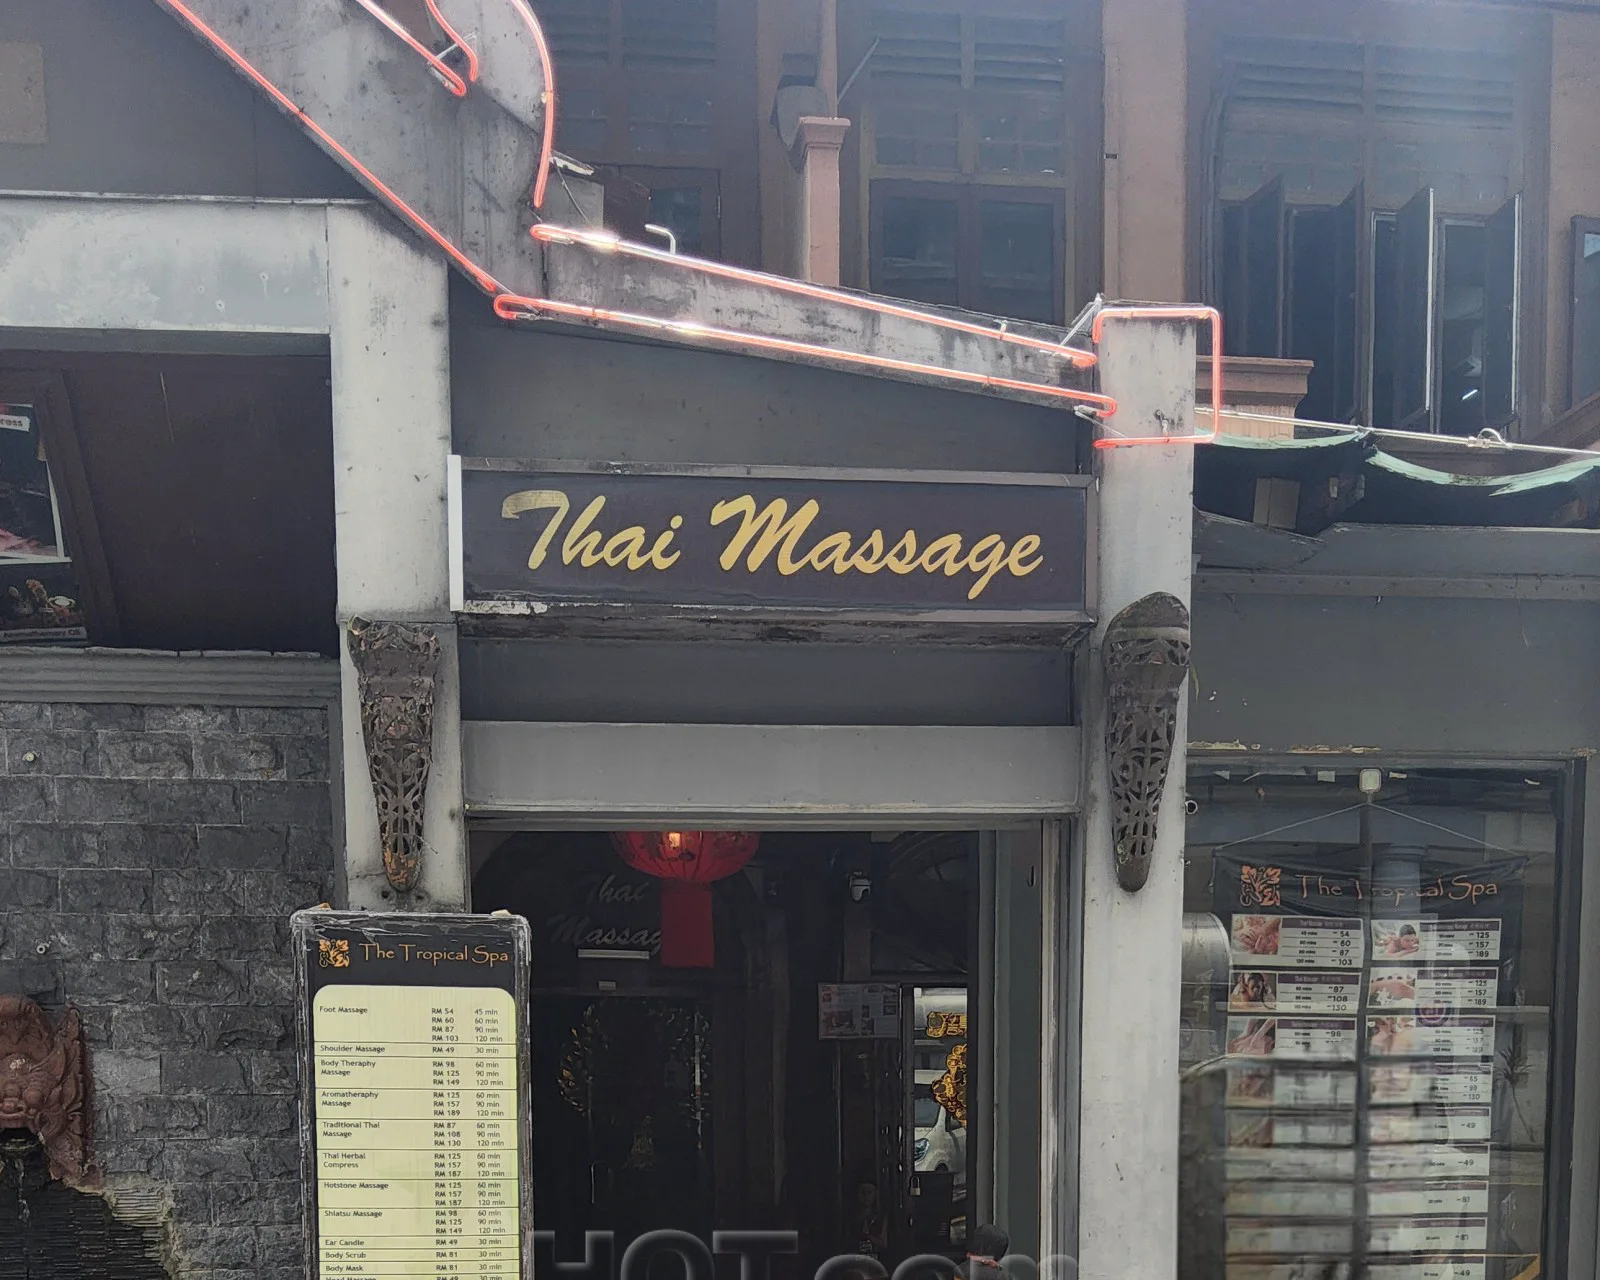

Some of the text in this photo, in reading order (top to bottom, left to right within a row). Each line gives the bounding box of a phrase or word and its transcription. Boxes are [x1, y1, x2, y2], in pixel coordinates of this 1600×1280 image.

[501, 489, 1044, 601] Thai Massage
[1295, 874, 1342, 899] The
[1447, 875, 1498, 906] Spa
[546, 914, 662, 956] Massag
[359, 943, 509, 967] The Tropical Spa
[431, 1016, 443, 1024] RM
[444, 1016, 455, 1024] 60
[446, 1034, 460, 1042] 103
[489, 1034, 503, 1042] min
[432, 1069, 444, 1077] RM
[447, 1069, 460, 1077] 125
[433, 1078, 444, 1086] RM
[447, 1078, 461, 1086] 149
[322, 1091, 378, 1099] Aromatheraphy
[433, 1091, 444, 1099] RM
[447, 1091, 461, 1099] 125
[447, 1100, 461, 1108] 157
[487, 1100, 500, 1108] min
[433, 1130, 445, 1138] RM
[448, 1130, 461, 1138] 108
[434, 1152, 446, 1160] RM
[448, 1152, 462, 1160] 125
[449, 1170, 462, 1178] 187
[435, 1190, 463, 1198] RM 157
[435, 1218, 463, 1226] RM 125
